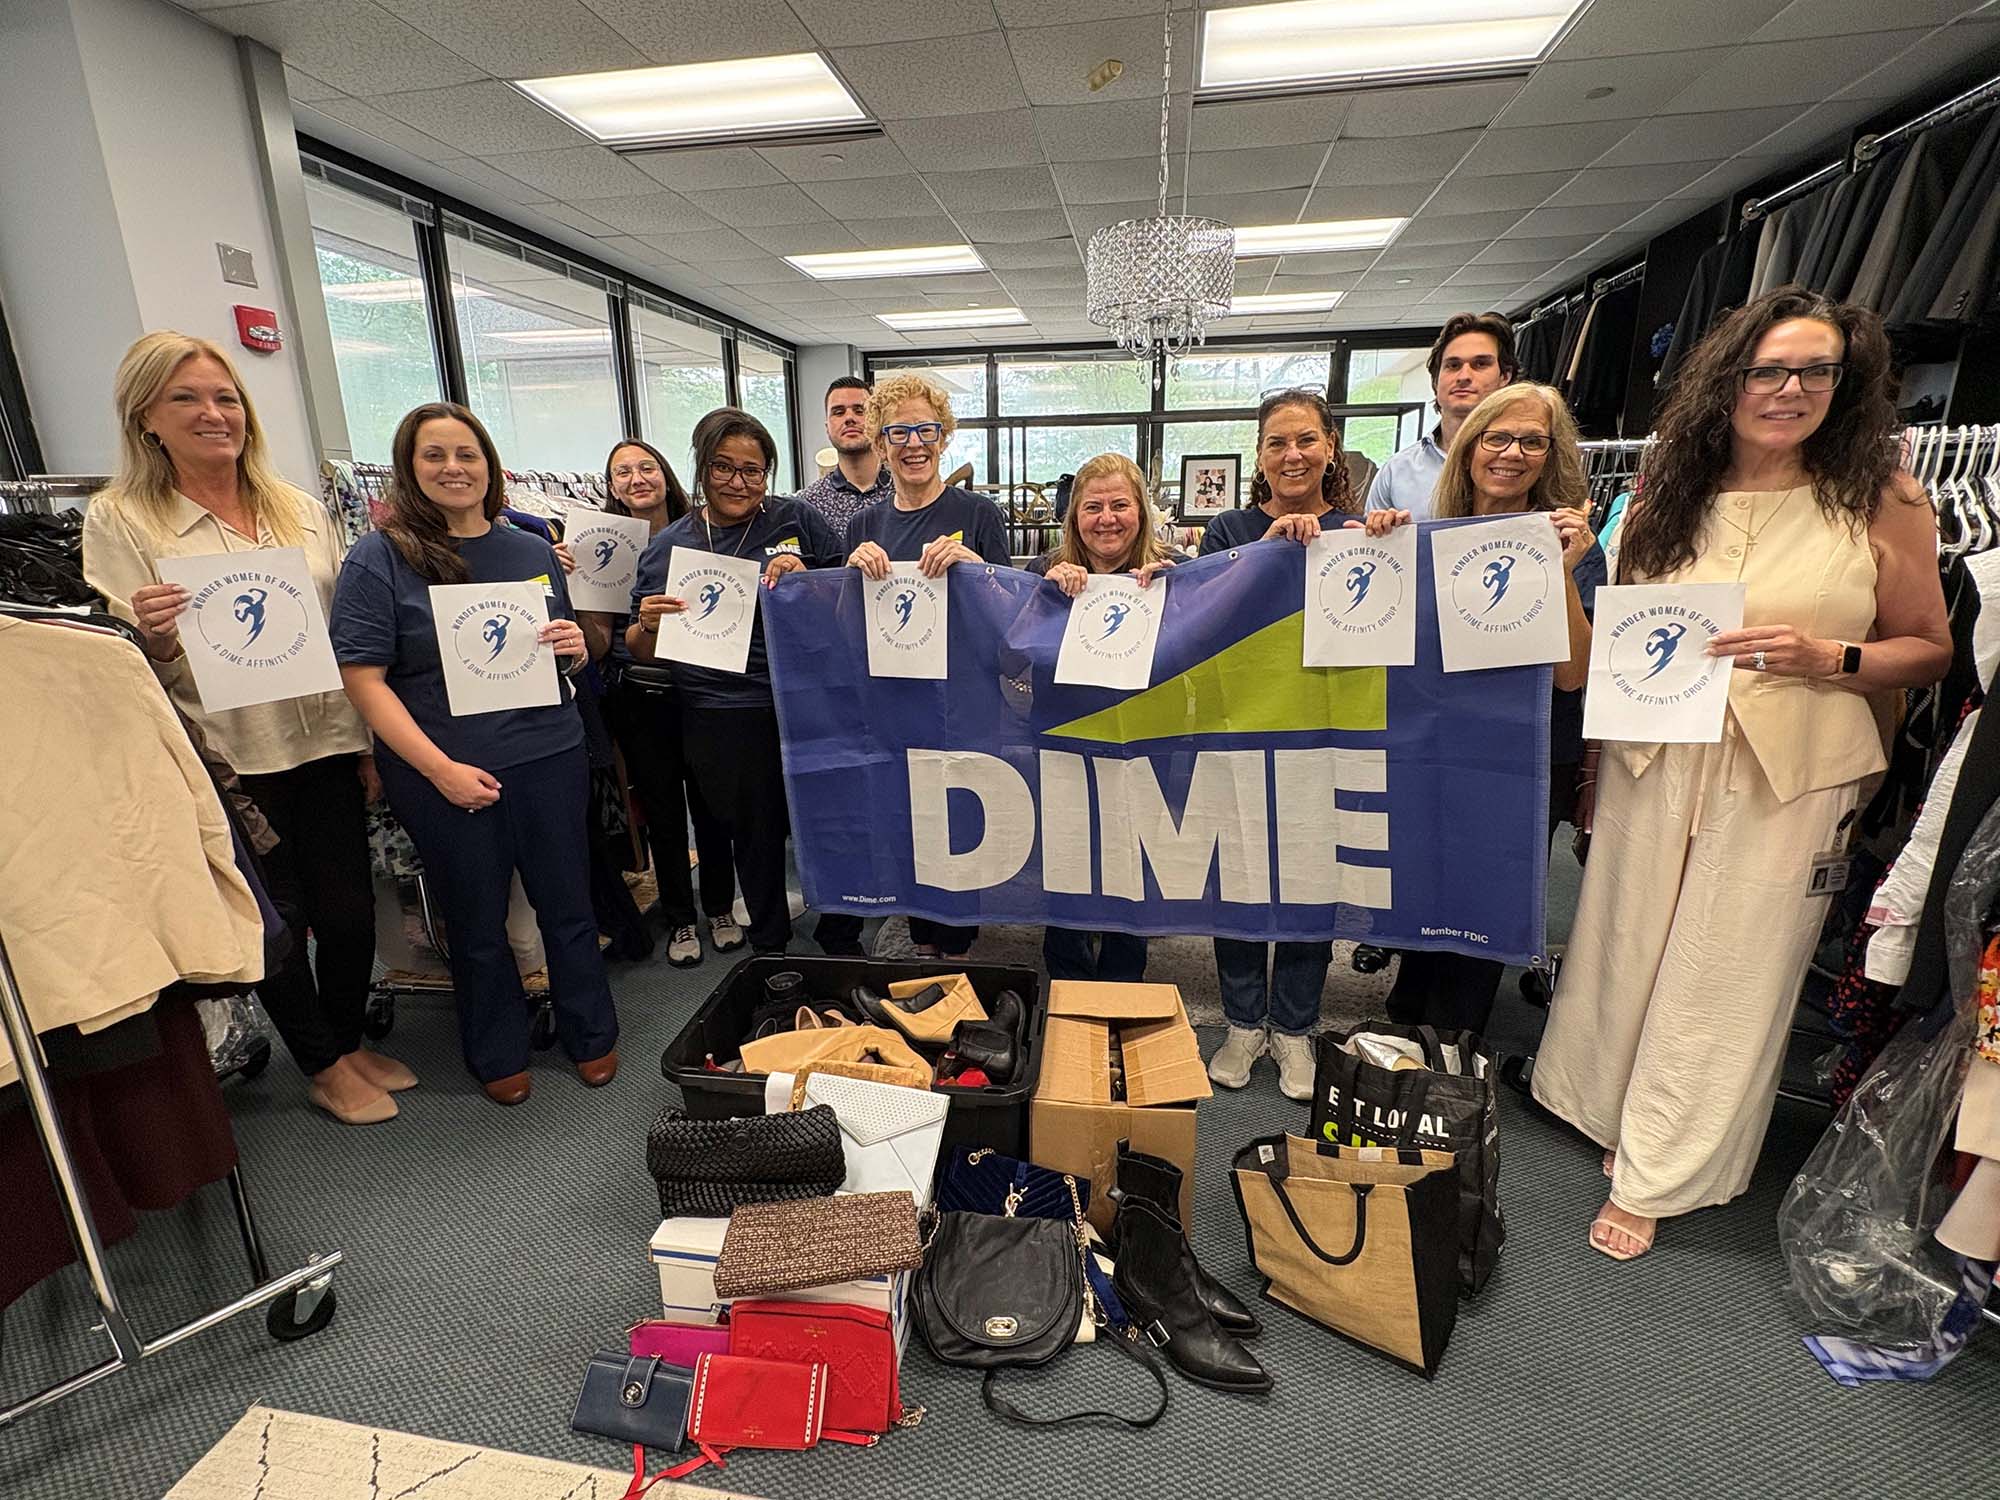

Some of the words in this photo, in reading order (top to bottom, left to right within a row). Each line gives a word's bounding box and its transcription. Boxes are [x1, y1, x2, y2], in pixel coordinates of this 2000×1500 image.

[765, 543, 802, 555] DIME
[1320, 552, 1345, 577] WONDER
[1347, 547, 1376, 556] WOMEN
[1377, 550, 1388, 560] OF
[1387, 557, 1403, 574] DIME
[1450, 548, 1479, 576] WONDER
[1480, 540, 1512, 552] WOMEN
[1515, 542, 1528, 551] OF
[1528, 548, 1548, 565] DIME
[192, 580, 223, 609] WONDER
[223, 572, 260, 584] WOMEN
[265, 575, 278, 585] OF
[279, 581, 302, 599] DIME
[452, 605, 477, 630] WONDER
[478, 601, 507, 610] WOMEN
[509, 604, 519, 612] OF
[520, 610, 537, 625] DIME
[1326, 613, 1342, 628] DIME
[1342, 623, 1376, 633] AFFINITY
[1378, 606, 1397, 627] GROUP
[1463, 613, 1483, 630] DIME
[1484, 620, 1522, 632] AFFINITY
[1523, 599, 1544, 622] GROUP
[1610, 611, 1646, 638] WONDER
[1648, 606, 1686, 616] WOMEN
[1688, 611, 1703, 621] OF
[1701, 619, 1721, 635] DIM
[1616, 679, 1637, 697] DIME
[1636, 693, 1680, 705] AFFINITY
[1683, 675, 1710, 698] GROUP
[906, 748, 1392, 909] DIME
[841, 895, 897, 903] www.Dime.com
[1421, 927, 1461, 936] Member
[1464, 930, 1489, 943] FDIC
[1328, 1085, 1365, 1117] ET
[1373, 1106, 1450, 1138] LOAL
